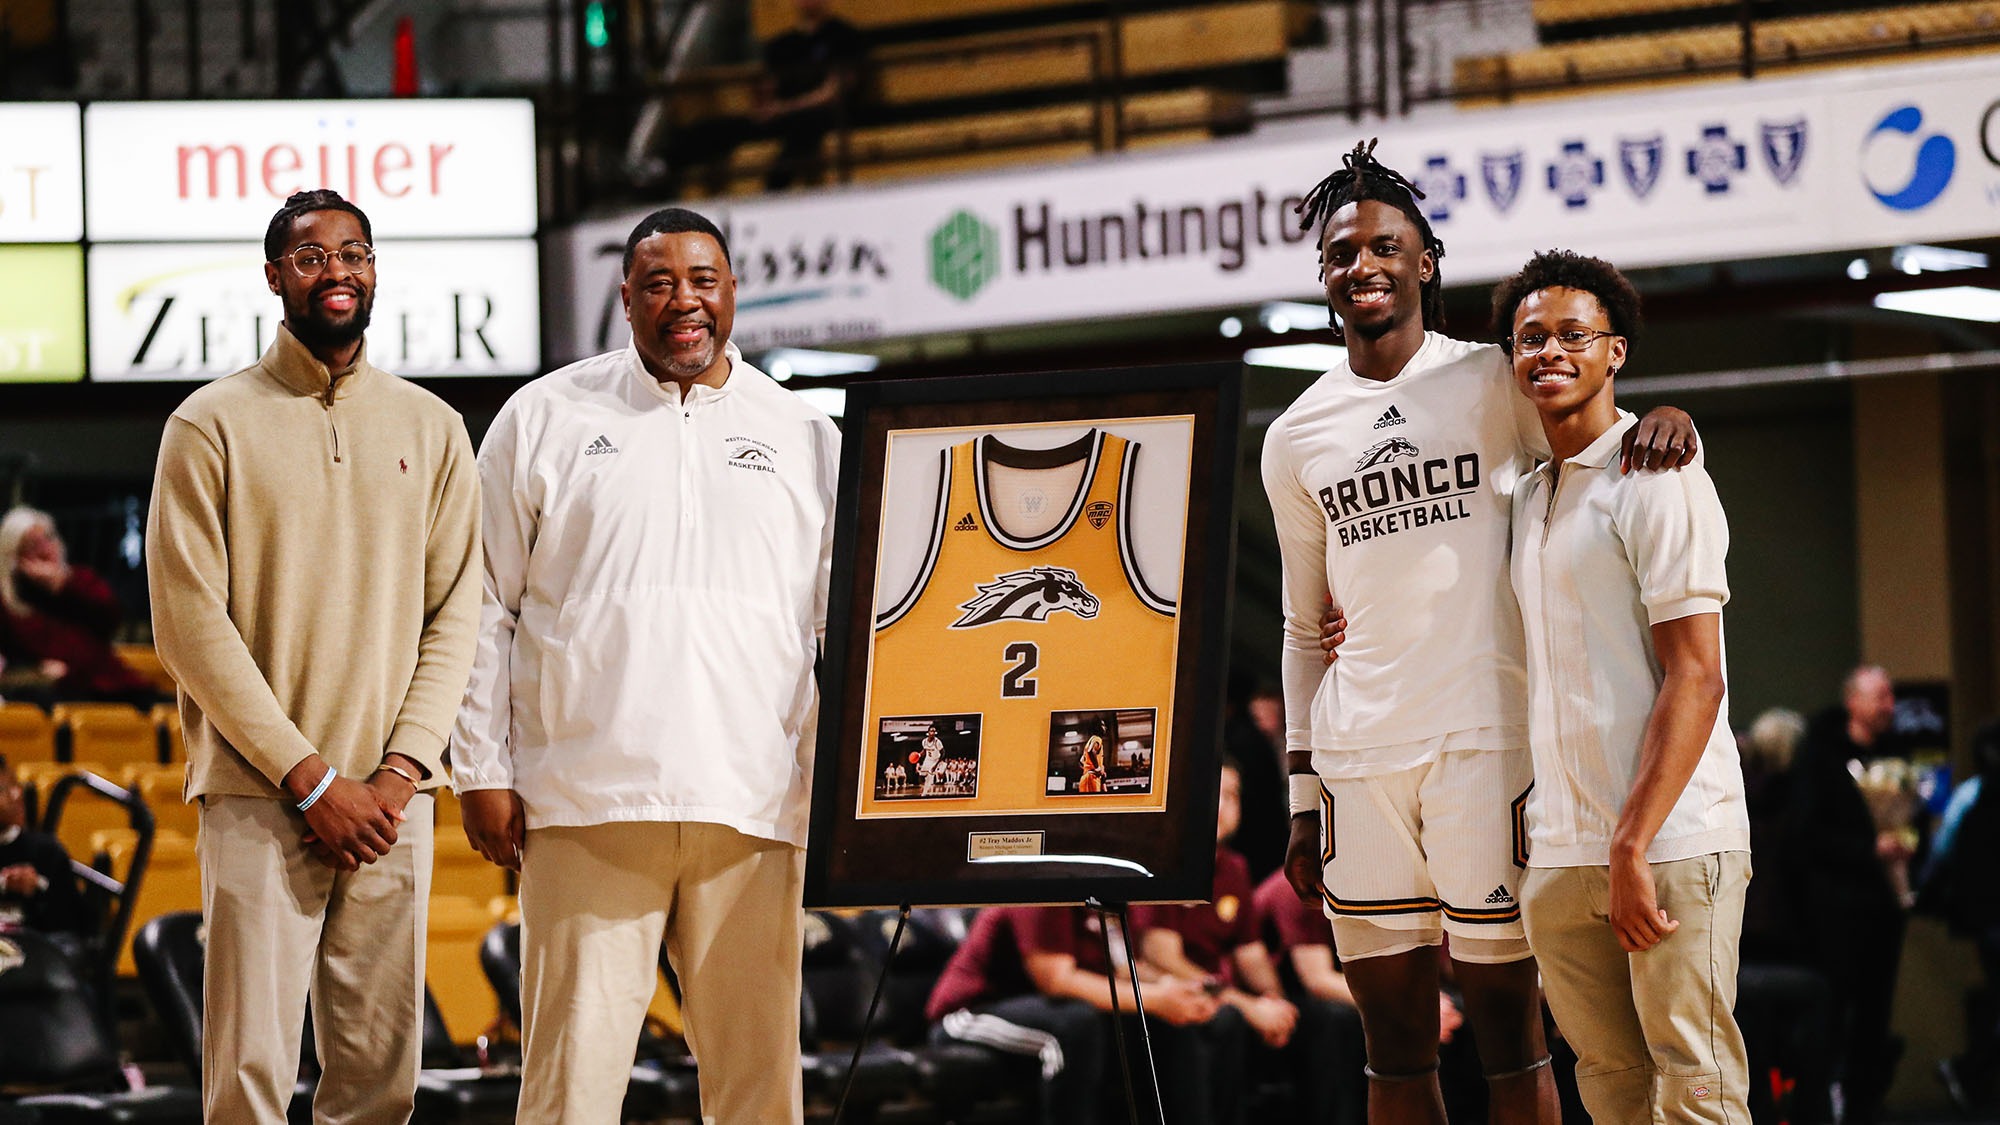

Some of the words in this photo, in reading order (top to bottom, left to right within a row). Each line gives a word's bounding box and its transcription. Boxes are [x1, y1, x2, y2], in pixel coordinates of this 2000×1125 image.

[176, 119, 456, 206] meijer
[1013, 188, 1309, 272] Huntingto
[130, 290, 496, 366] ZEIER
[1373, 415, 1407, 430] adidas
[584, 446, 619, 456] adidas
[728, 460, 776, 474] BASKETBALL
[1318, 452, 1480, 523] BRONCO
[954, 523, 978, 531] adidas
[1088, 509, 1110, 518] MAC
[1337, 498, 1471, 548] BASKETBALL
[1001, 640, 1039, 699] 2
